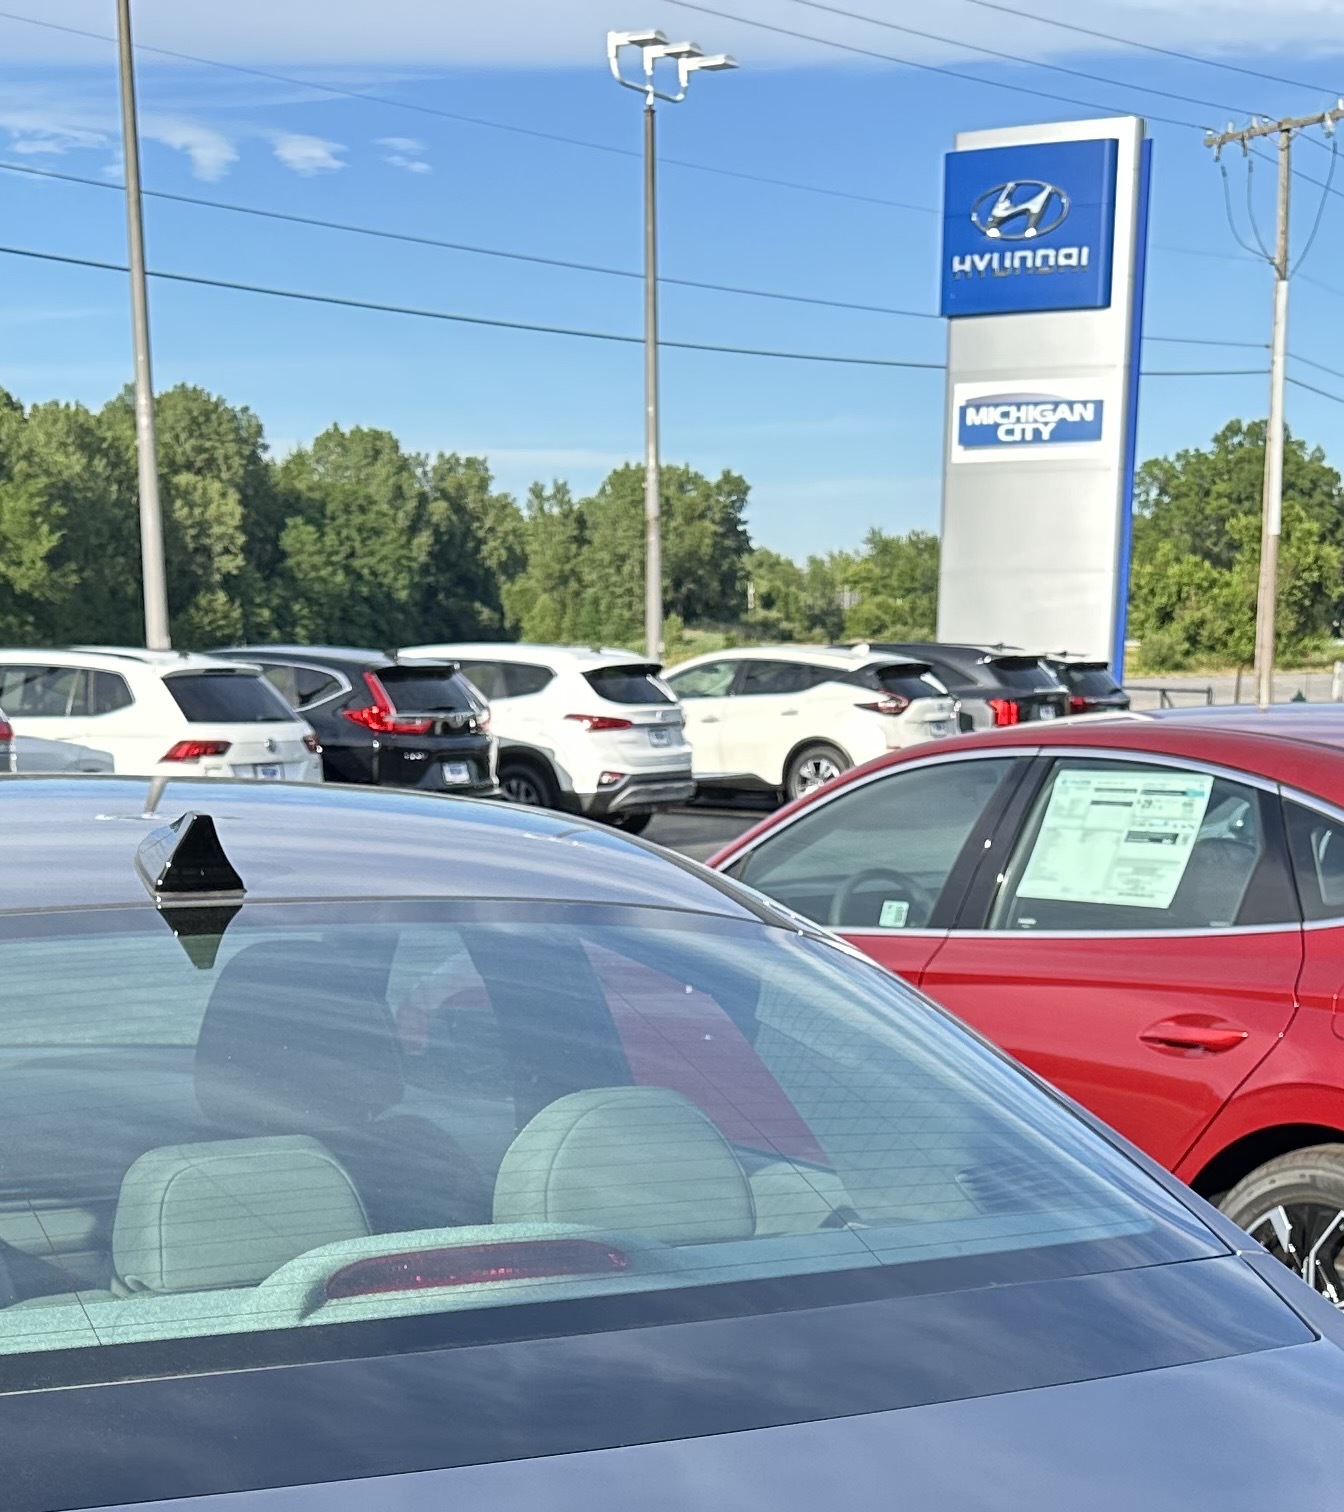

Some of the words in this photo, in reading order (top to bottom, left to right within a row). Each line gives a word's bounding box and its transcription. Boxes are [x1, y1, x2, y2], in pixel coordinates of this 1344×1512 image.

[952, 246, 1090, 274] HYUNDAI
[965, 403, 1095, 427] MICHIGAN
[996, 423, 1057, 442] CITY
